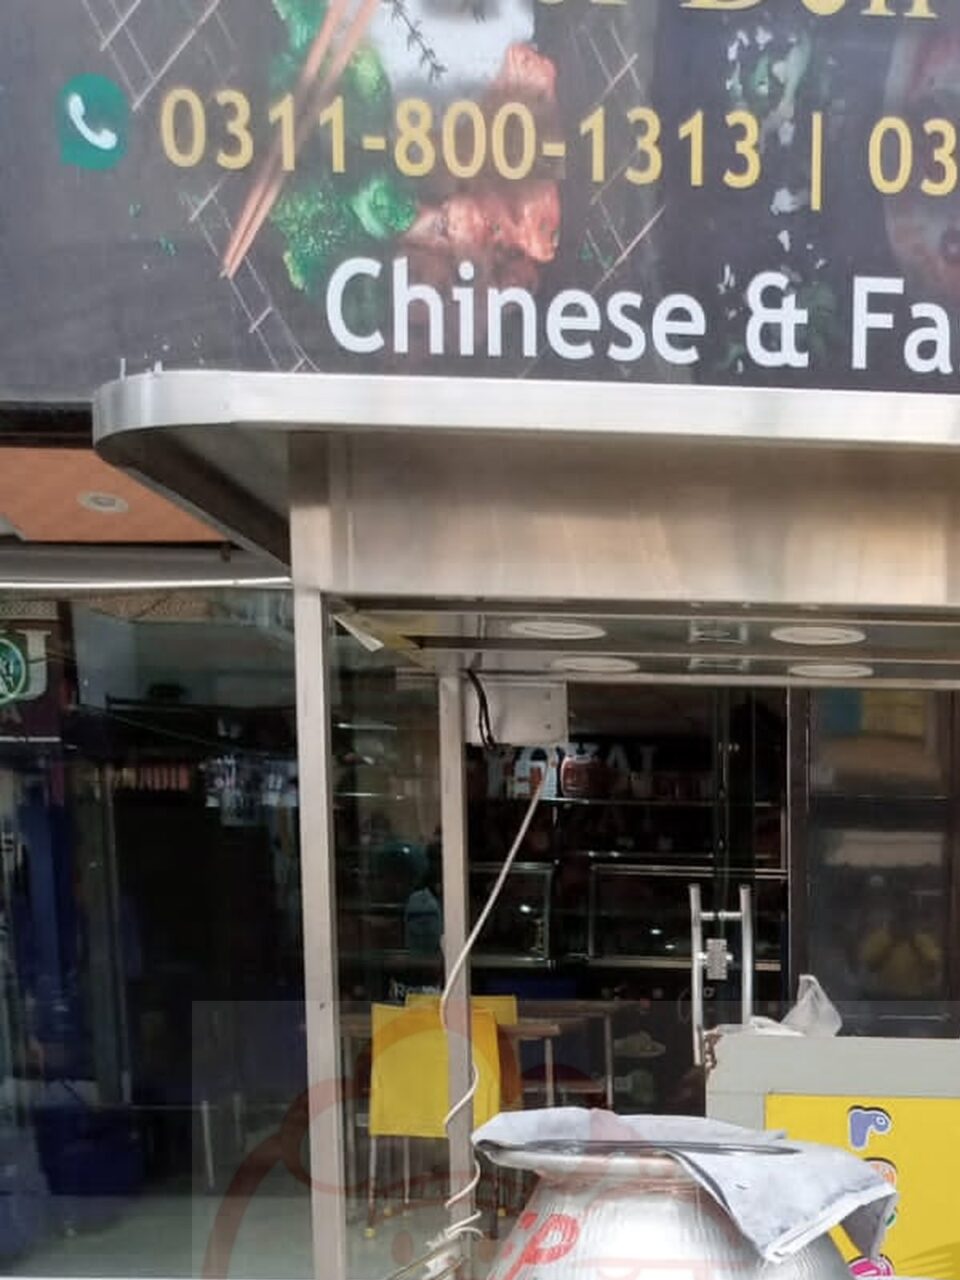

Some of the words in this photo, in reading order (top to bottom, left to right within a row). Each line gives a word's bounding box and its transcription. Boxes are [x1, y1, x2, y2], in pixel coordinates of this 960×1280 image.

[160, 87, 763, 190] 0311-800-1313
[326, 256, 707, 366] Chinese
[746, 271, 810, 368] &
